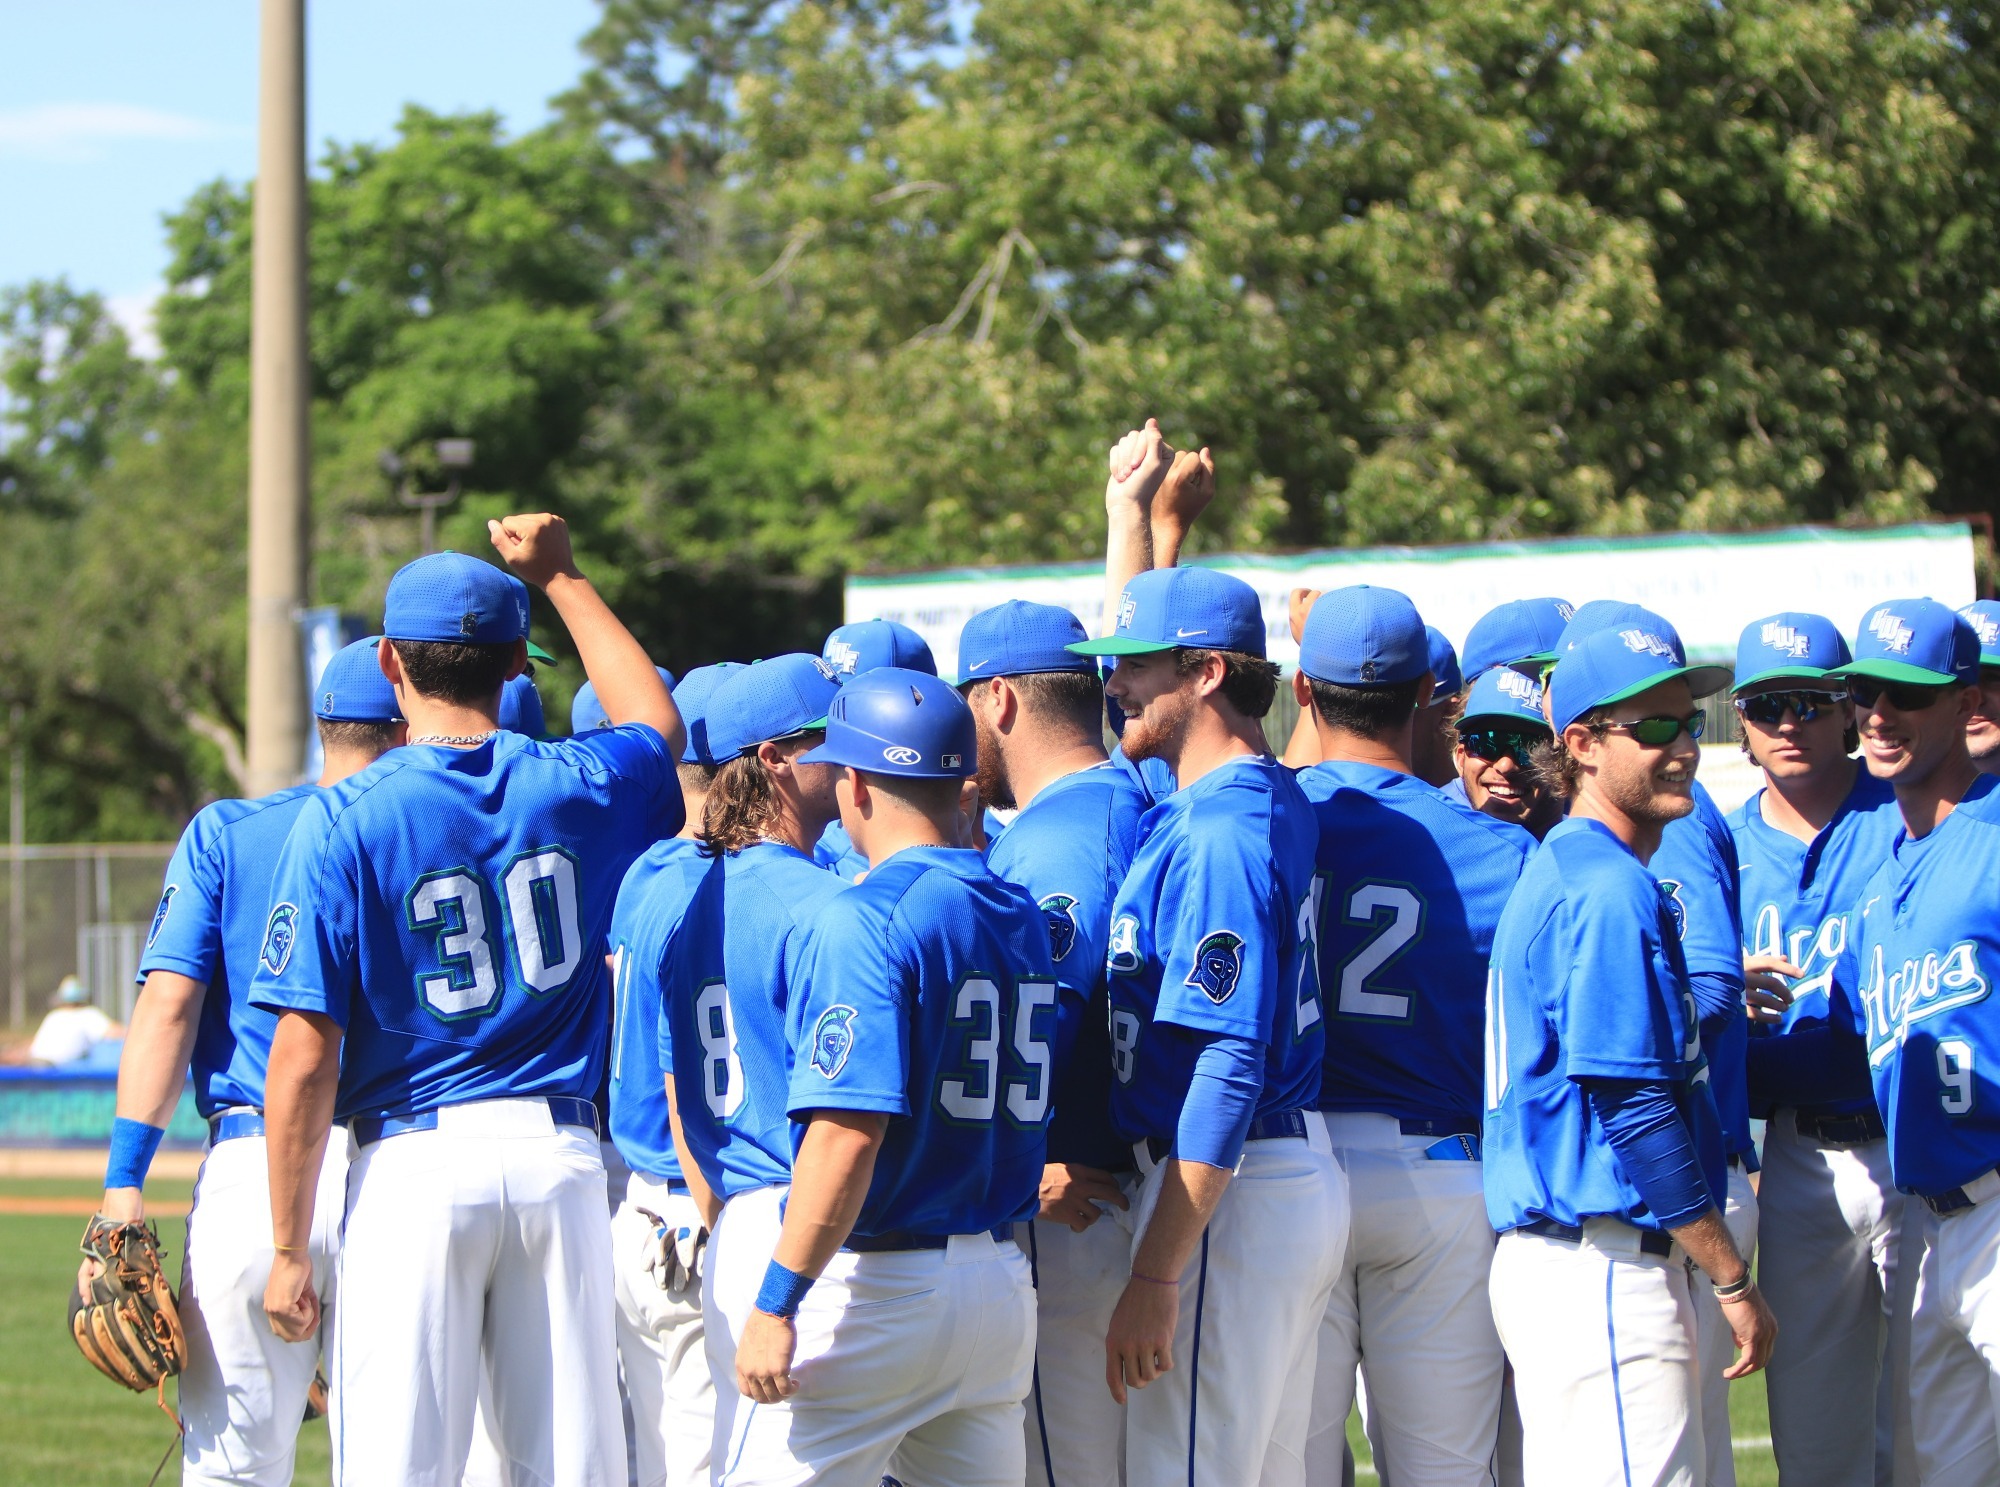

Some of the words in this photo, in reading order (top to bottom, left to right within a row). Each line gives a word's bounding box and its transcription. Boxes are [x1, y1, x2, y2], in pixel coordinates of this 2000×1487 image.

[1760, 620, 1810, 658] UWF
[1868, 608, 1915, 655] UWF
[409, 847, 585, 1018] 30
[695, 980, 746, 1121] 8
[938, 977, 1056, 1123] 35
[1860, 944, 1986, 1060] Argos
[1935, 1040, 1973, 1114] 9
